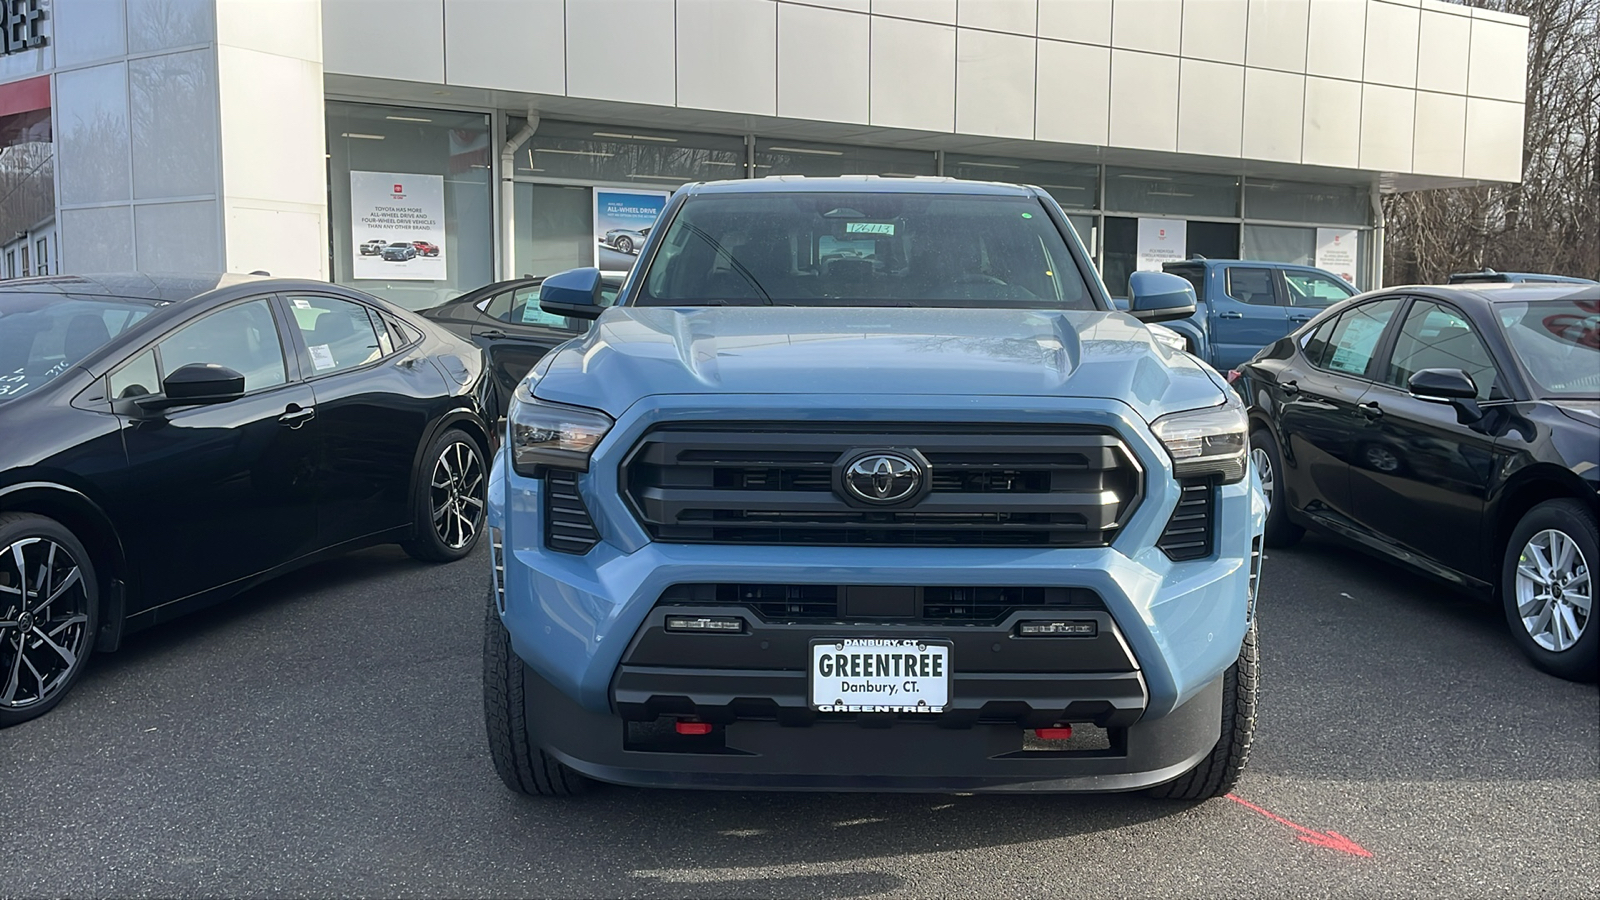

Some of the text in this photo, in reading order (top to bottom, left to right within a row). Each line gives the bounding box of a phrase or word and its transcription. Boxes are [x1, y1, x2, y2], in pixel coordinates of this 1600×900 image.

[819, 654, 942, 677] GREENTREE
[841, 680, 919, 696] Danbury, CT.
